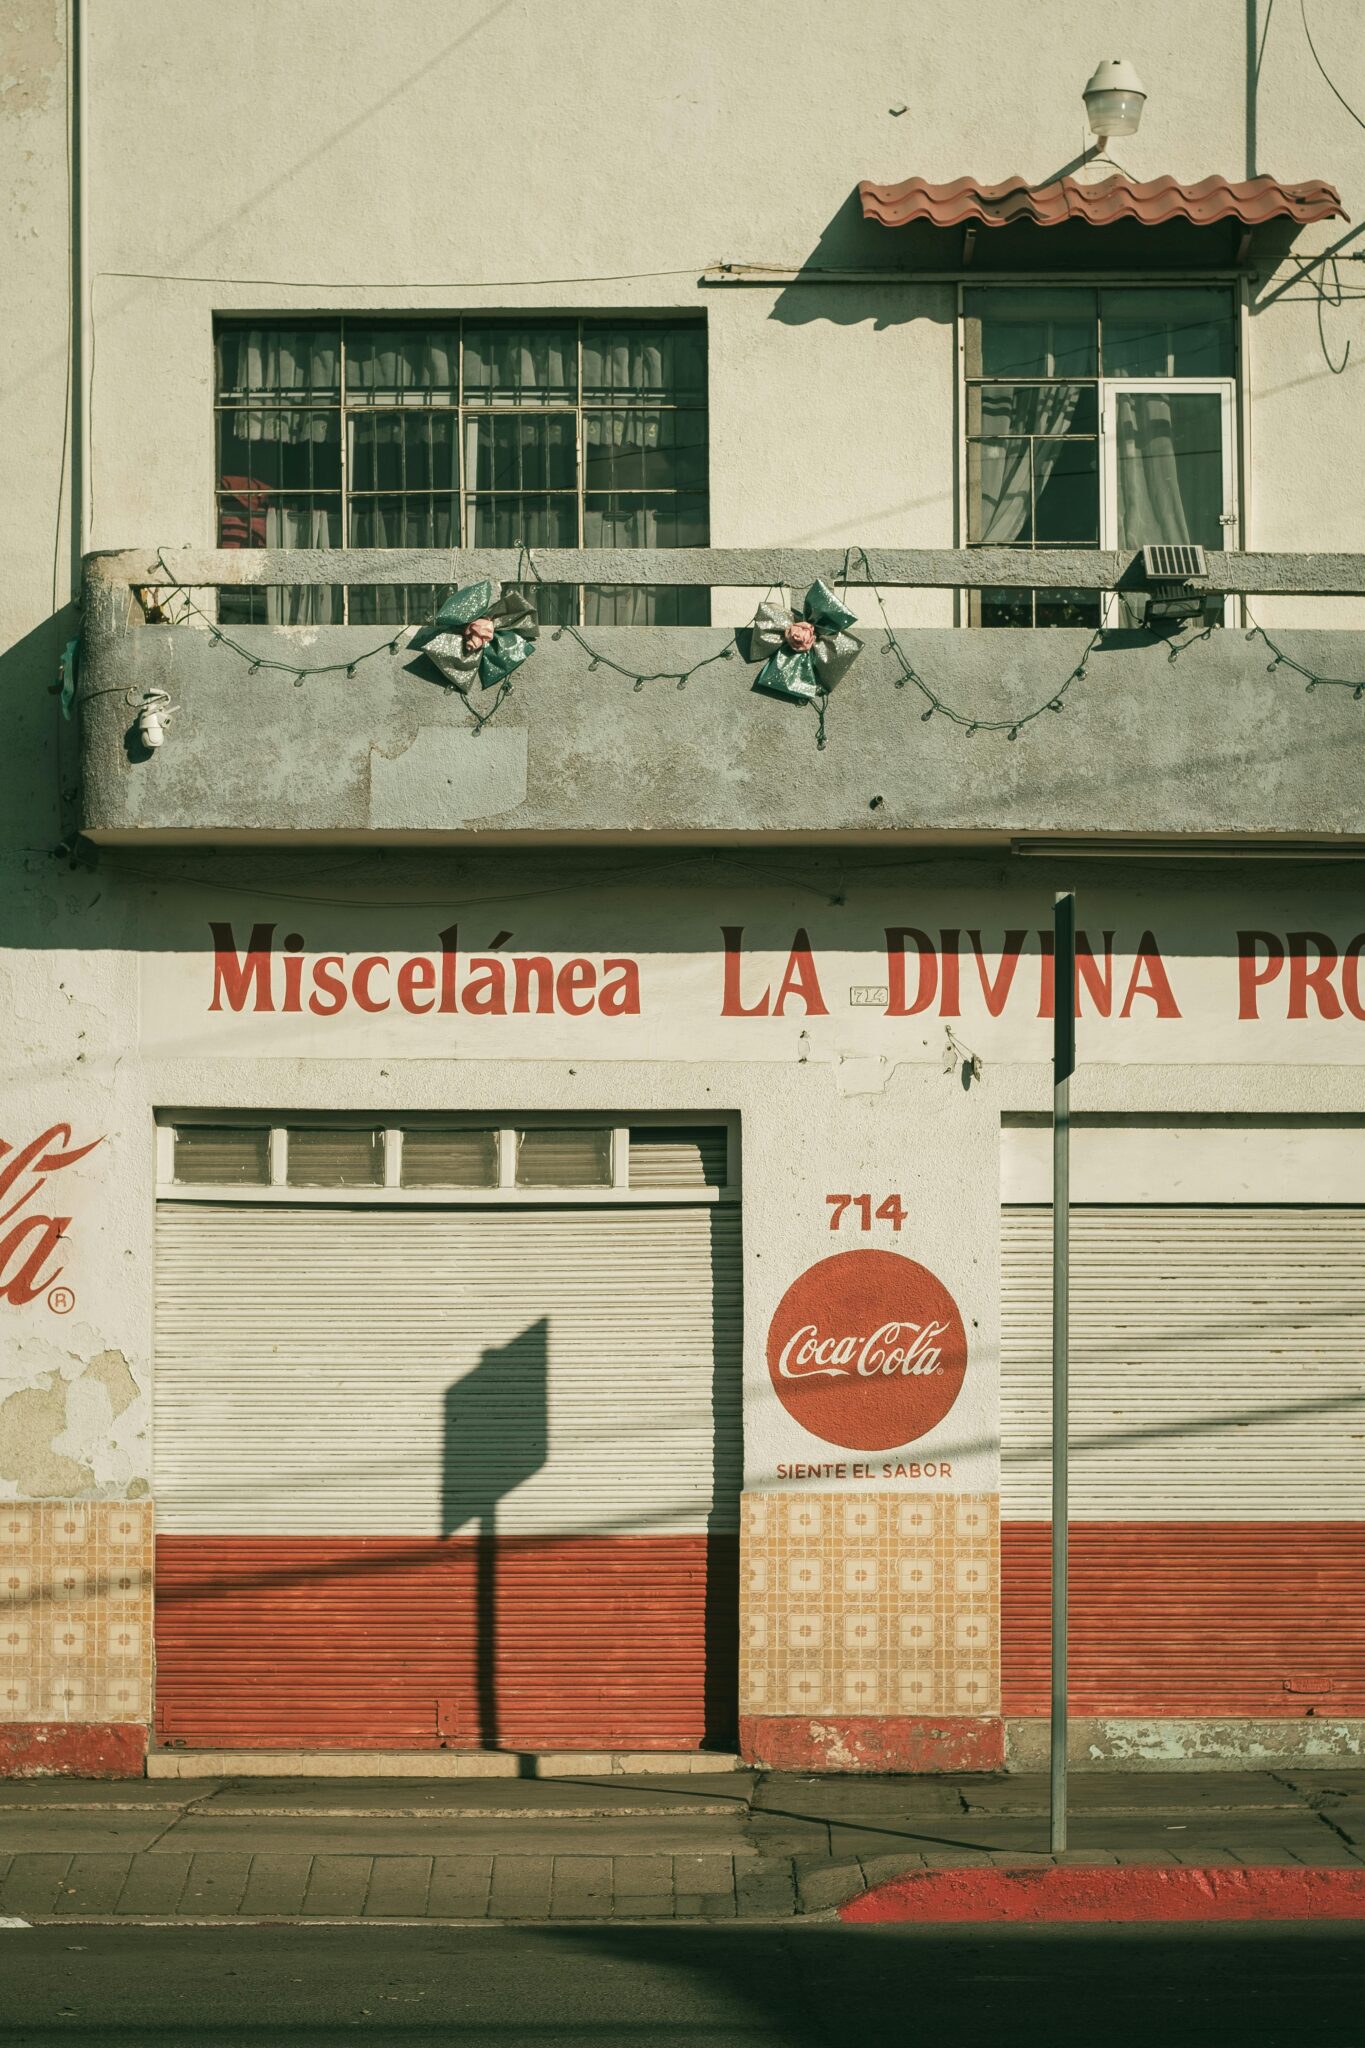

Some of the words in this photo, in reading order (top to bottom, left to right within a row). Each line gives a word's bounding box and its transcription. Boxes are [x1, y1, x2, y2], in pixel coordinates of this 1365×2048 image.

[208, 922, 641, 1017] Miscelánea
[719, 925, 830, 1018] LA
[883, 927, 1183, 1019] DIVINA
[853, 988, 885, 1003] 714
[825, 1193, 909, 1232] 714
[778, 1320, 951, 1379] Coca-Cola
[776, 1463, 847, 1480] SIENTE
[852, 1463, 876, 1479] EL
[882, 1462, 952, 1479] SABOR
